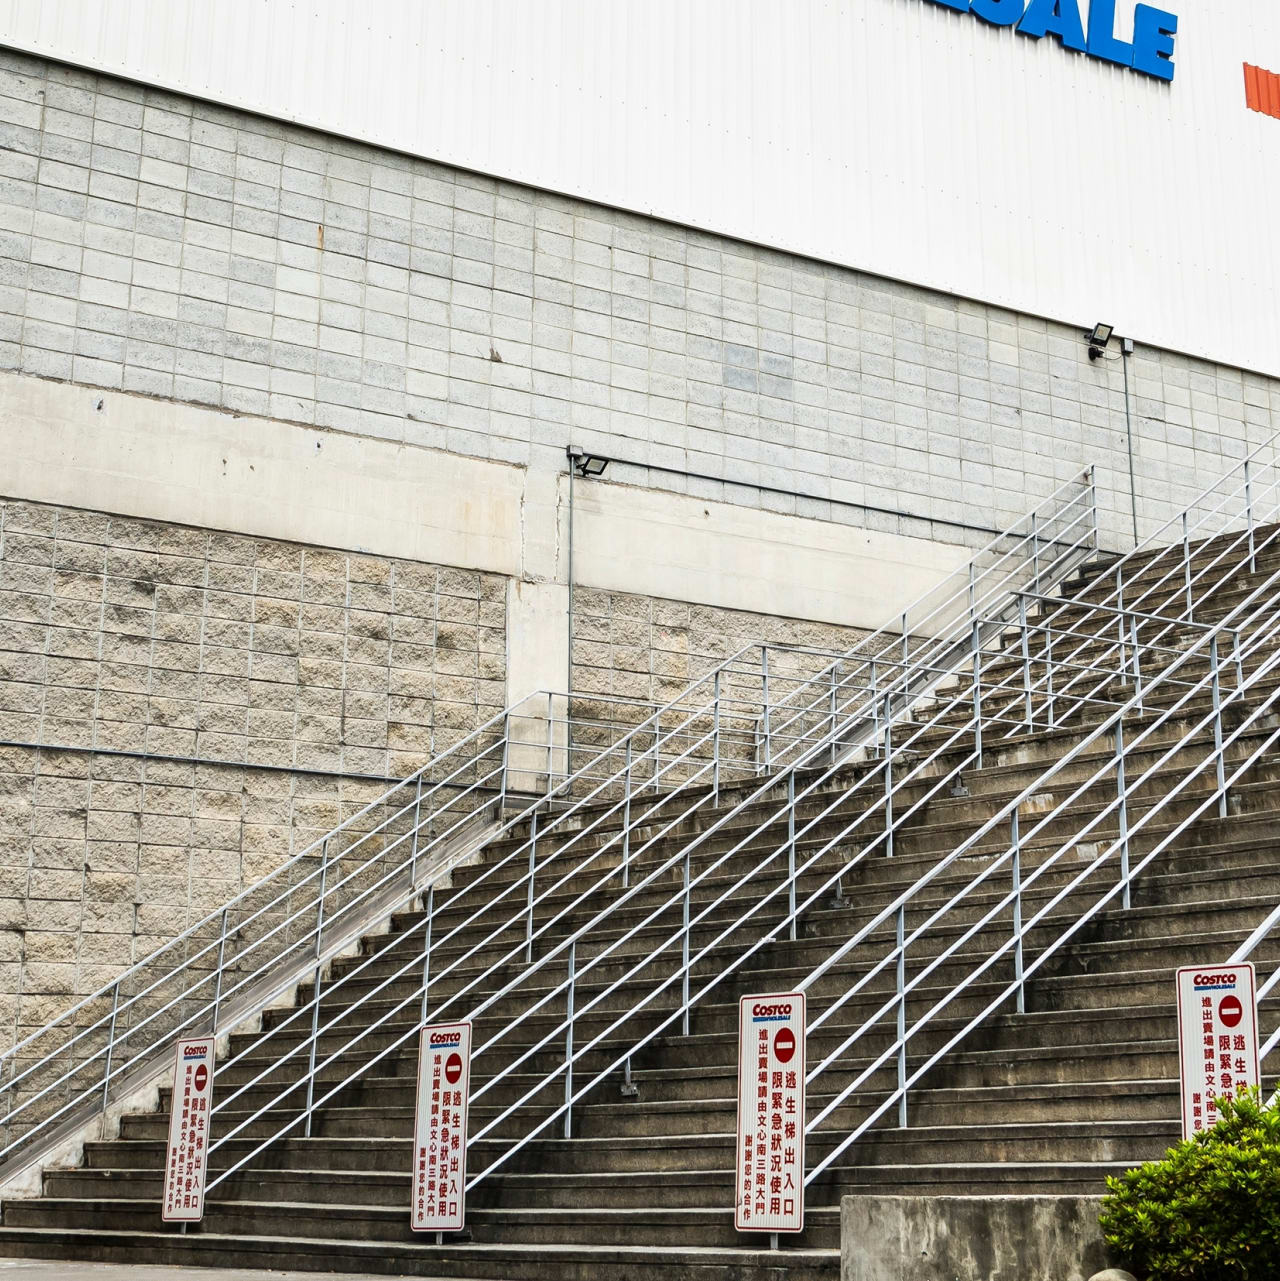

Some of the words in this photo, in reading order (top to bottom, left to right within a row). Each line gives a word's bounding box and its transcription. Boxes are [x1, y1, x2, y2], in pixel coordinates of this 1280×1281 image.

[430, 1032, 461, 1044] COSTCO
[752, 1003, 792, 1016] COSTCO
[1193, 973, 1236, 985] COSTCO
[184, 1045, 208, 1056] COSTCO
[1201, 996, 1217, 1132] 進出賣場請由文心南三
[191, 1097, 207, 1208] 逃生梯出入口
[438, 1091, 452, 1217] 限緊急狀況使用
[448, 1091, 462, 1217] 逃生梯出入口
[743, 1134, 753, 1221] 謝謝您的合作
[755, 1028, 768, 1216] 進出賣場請由文心南三路大門
[770, 1071, 783, 1216] 限緊急狀況使用
[783, 1071, 796, 1216] 逃生梯出入口
